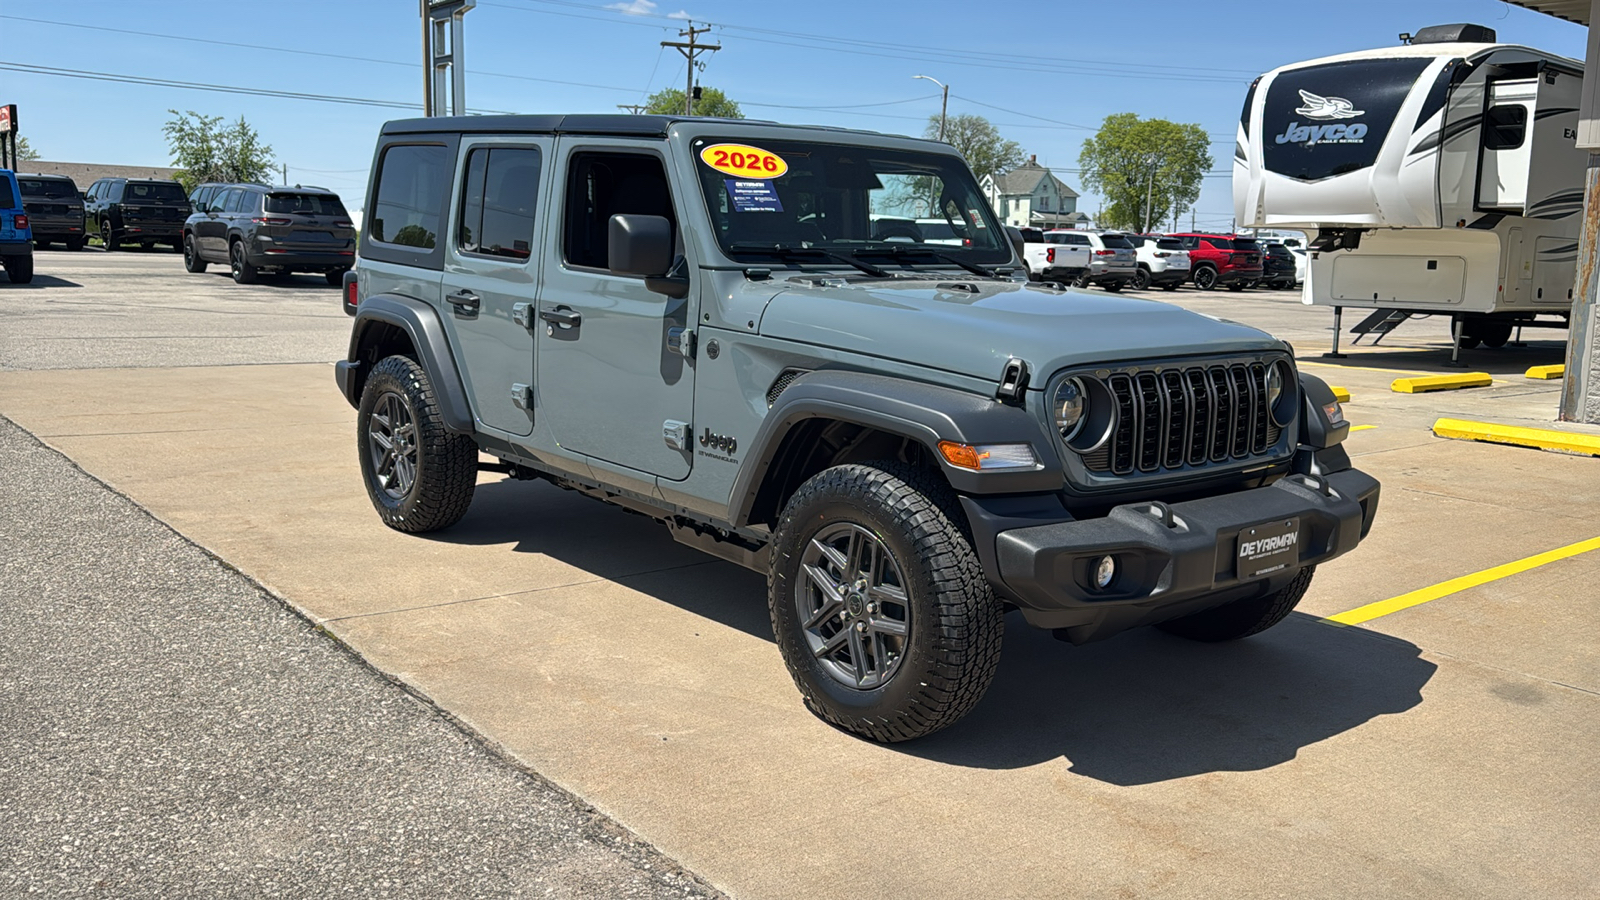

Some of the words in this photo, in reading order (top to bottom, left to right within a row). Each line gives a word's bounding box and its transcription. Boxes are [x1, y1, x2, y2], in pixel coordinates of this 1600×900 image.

[1275, 122, 1368, 145] Jayco
[713, 150, 777, 172] 2026
[699, 427, 737, 457] Jeep
[705, 451, 739, 465] WRANGLER
[1239, 531, 1298, 557] DEYARMAN
[1248, 551, 1272, 560] AUTOMOTIVE
